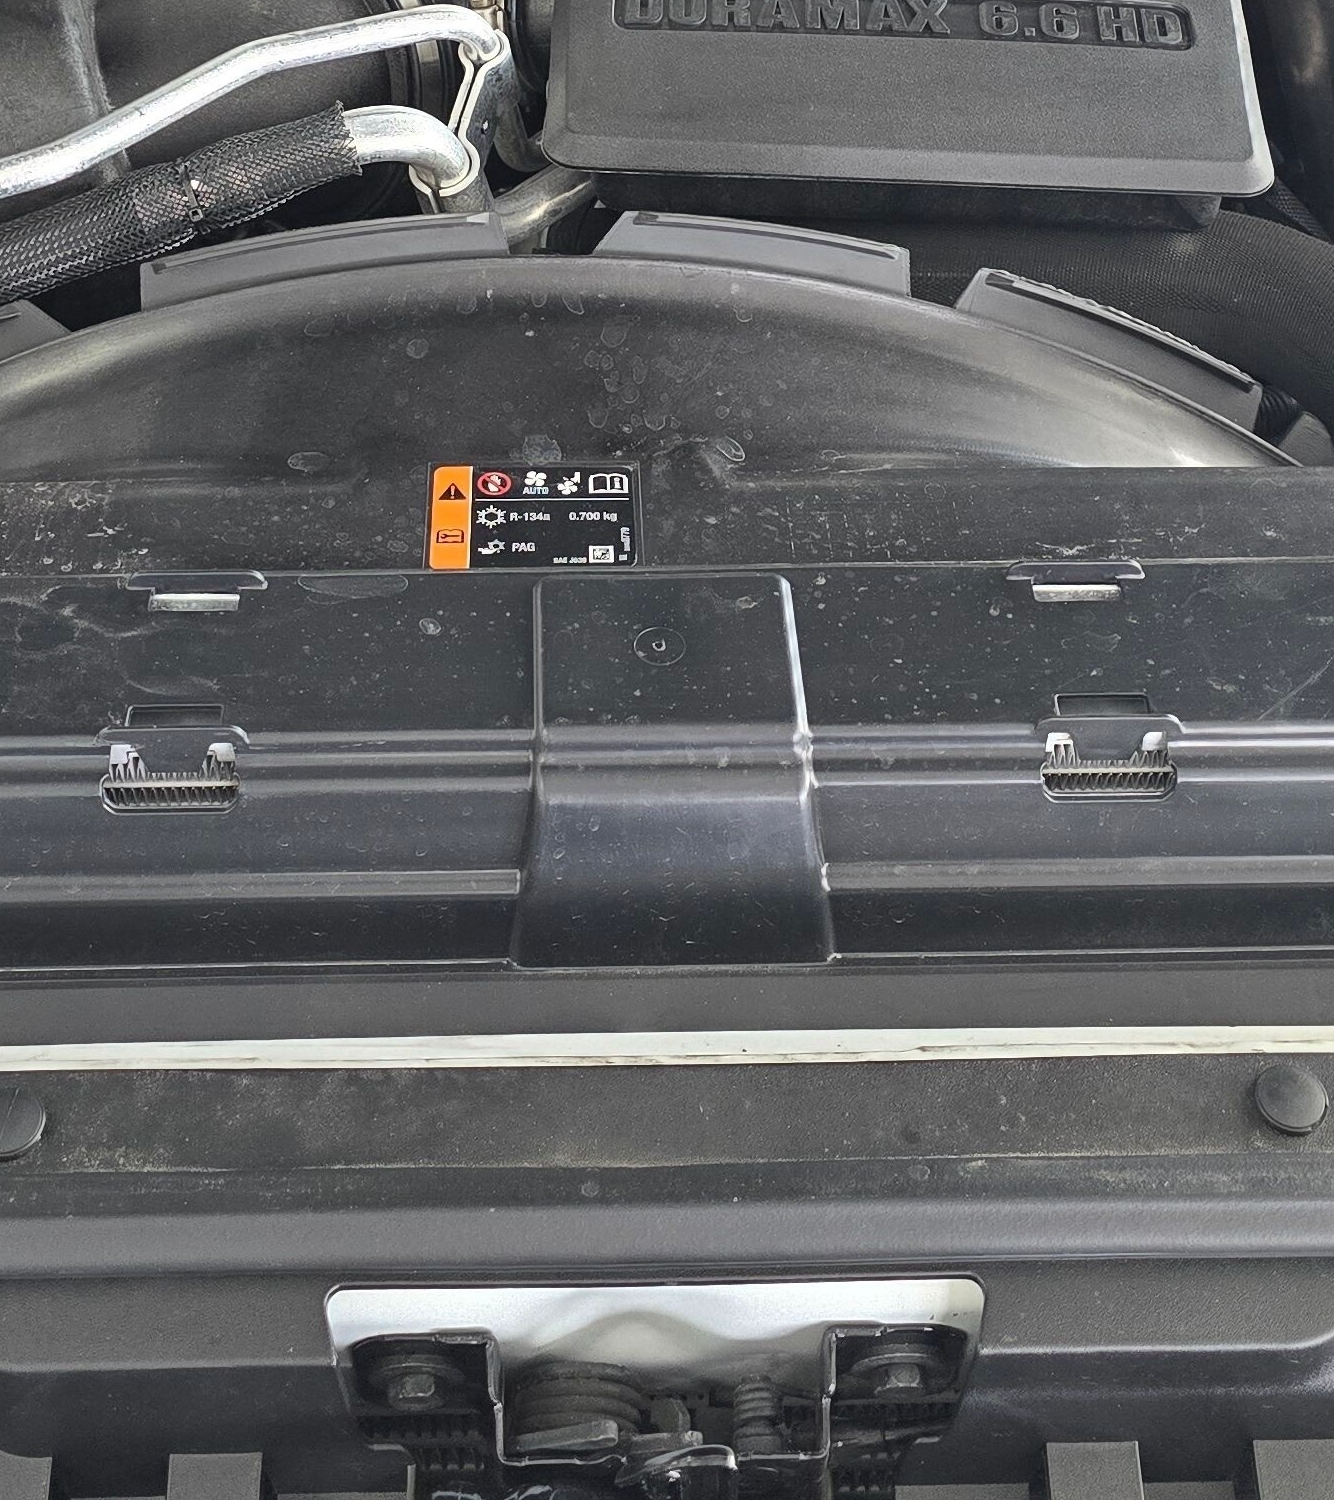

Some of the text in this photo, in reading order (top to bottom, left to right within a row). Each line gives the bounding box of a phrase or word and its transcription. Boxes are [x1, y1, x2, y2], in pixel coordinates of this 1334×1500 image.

[979, 0, 1082, 40] 6.6
[1098, 6, 1185, 44] HD
[523, 486, 549, 495] AUTO
[509, 512, 618, 522] R-134a 0.700 kg
[511, 542, 536, 552] PAG
